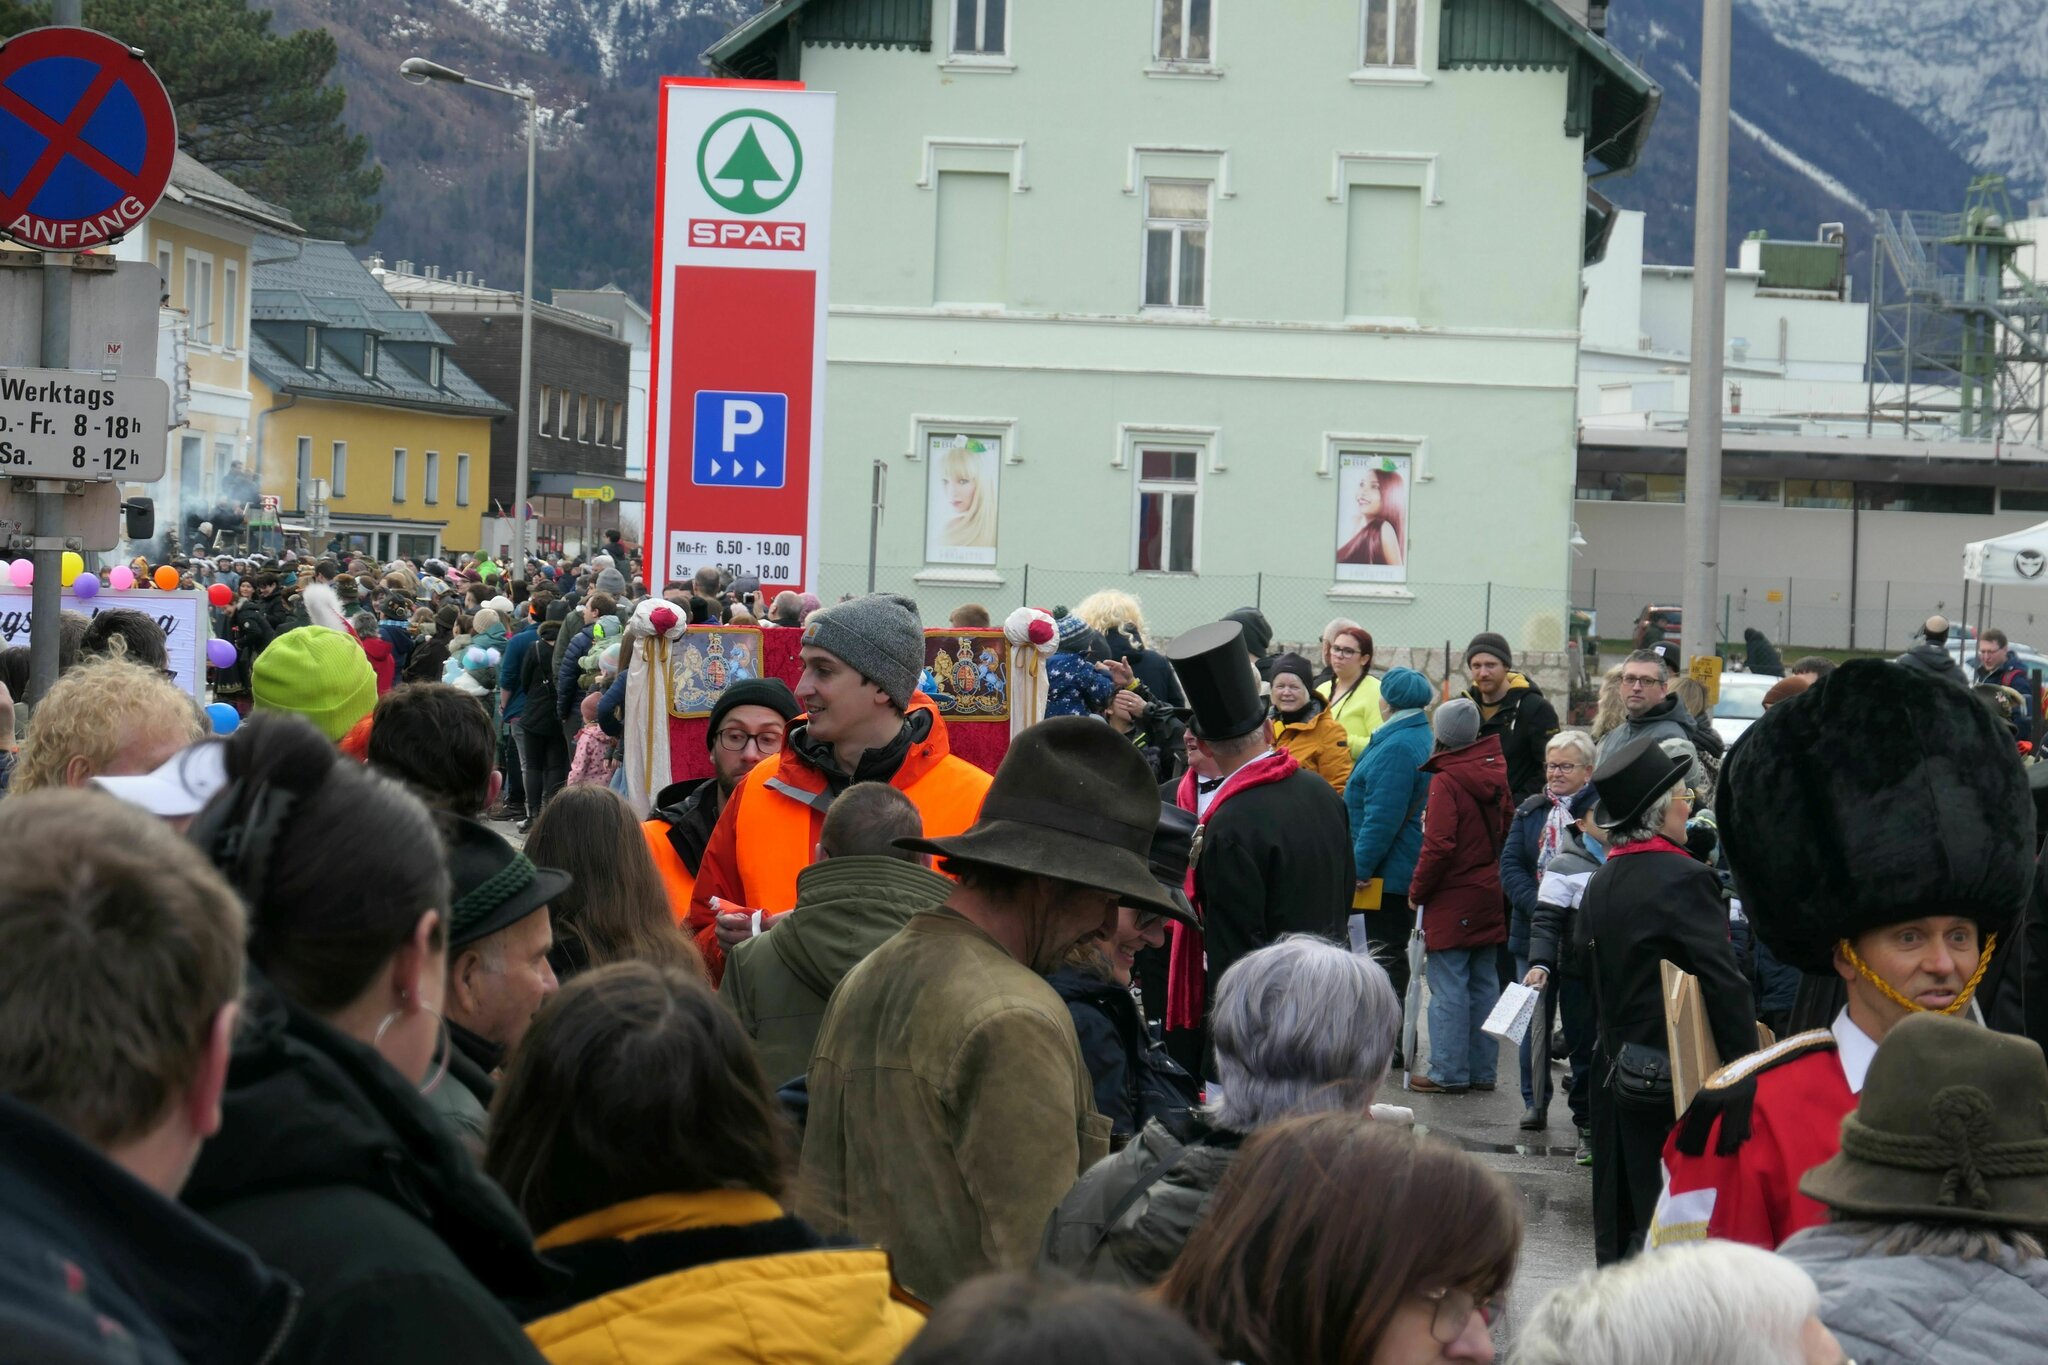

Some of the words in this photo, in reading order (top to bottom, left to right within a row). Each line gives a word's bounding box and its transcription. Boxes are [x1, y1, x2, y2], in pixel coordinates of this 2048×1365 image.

[8, 196, 145, 244] ANFANG
[692, 222, 801, 247] SPAR
[1, 377, 115, 411] Werktags
[722, 399, 764, 452] P
[0, 441, 33, 465] Sa.
[677, 541, 707, 553] Mo-Fr:
[716, 540, 743, 555] 6.50
[757, 541, 790, 556] 19.00
[676, 564, 691, 576] Sa:
[755, 564, 789, 580] 18.00
